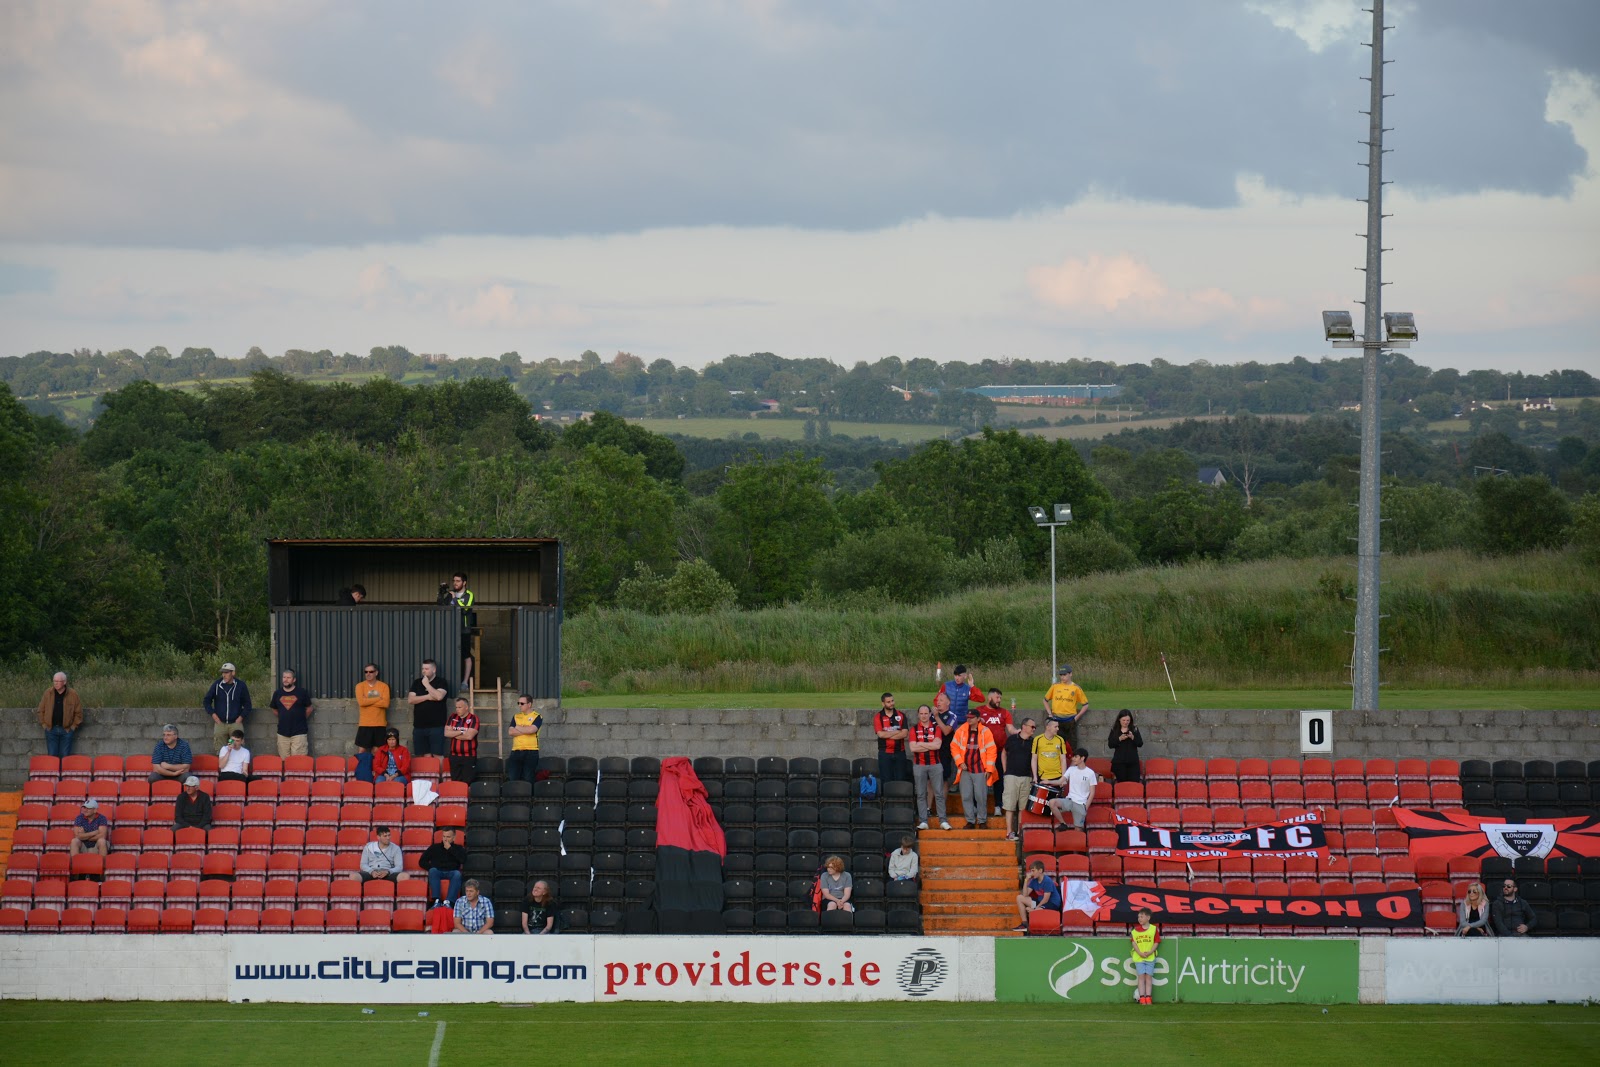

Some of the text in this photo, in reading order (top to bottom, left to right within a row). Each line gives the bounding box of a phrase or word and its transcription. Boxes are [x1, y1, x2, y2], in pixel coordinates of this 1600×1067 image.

[1182, 834, 1231, 842] SECTION
[1256, 825, 1314, 849] FC
[1127, 850, 1171, 858] THEN
[1126, 892, 1362, 918] SECTION
[235, 956, 587, 984] www.citycalling.com
[604, 950, 881, 995] providers.ie
[1177, 957, 1306, 993] Airtricity
